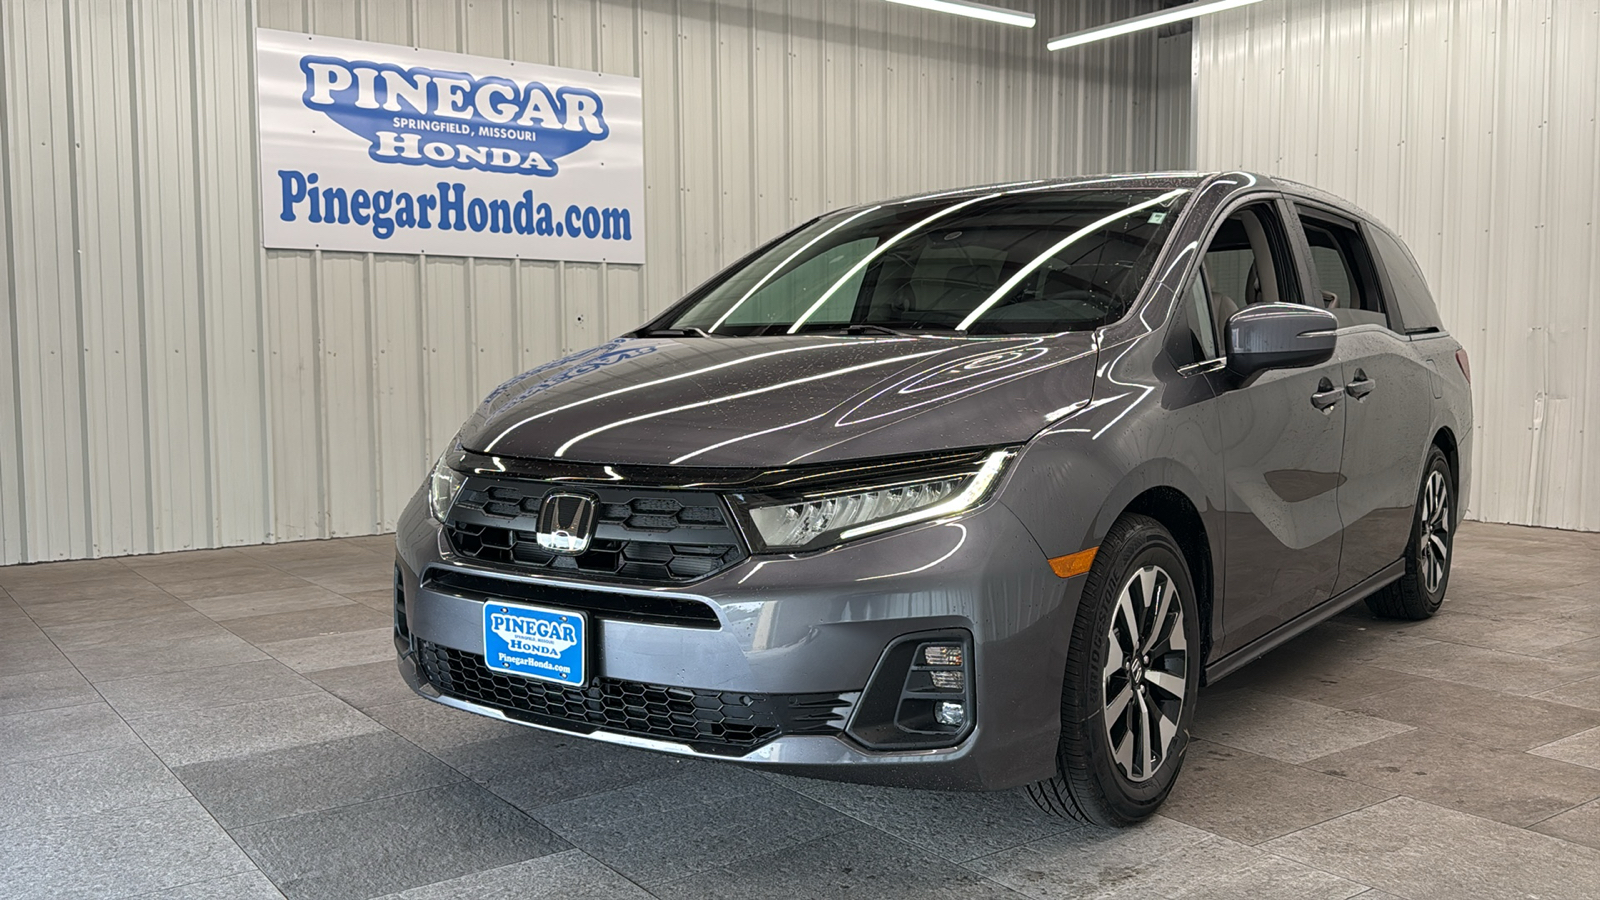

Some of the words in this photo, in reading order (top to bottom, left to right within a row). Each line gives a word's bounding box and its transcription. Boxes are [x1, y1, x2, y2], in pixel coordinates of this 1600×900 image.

[306, 61, 605, 134] PINEGAR
[392, 116, 476, 138] SPRINGFIELD,
[478, 126, 537, 142] MISSOURI
[374, 130, 554, 171] HONDA
[277, 169, 633, 240] PinegarHonda.com
[492, 615, 576, 643] PINEGAR
[509, 639, 559, 656] HONDA
[498, 652, 571, 674] PinegarHonda.com
